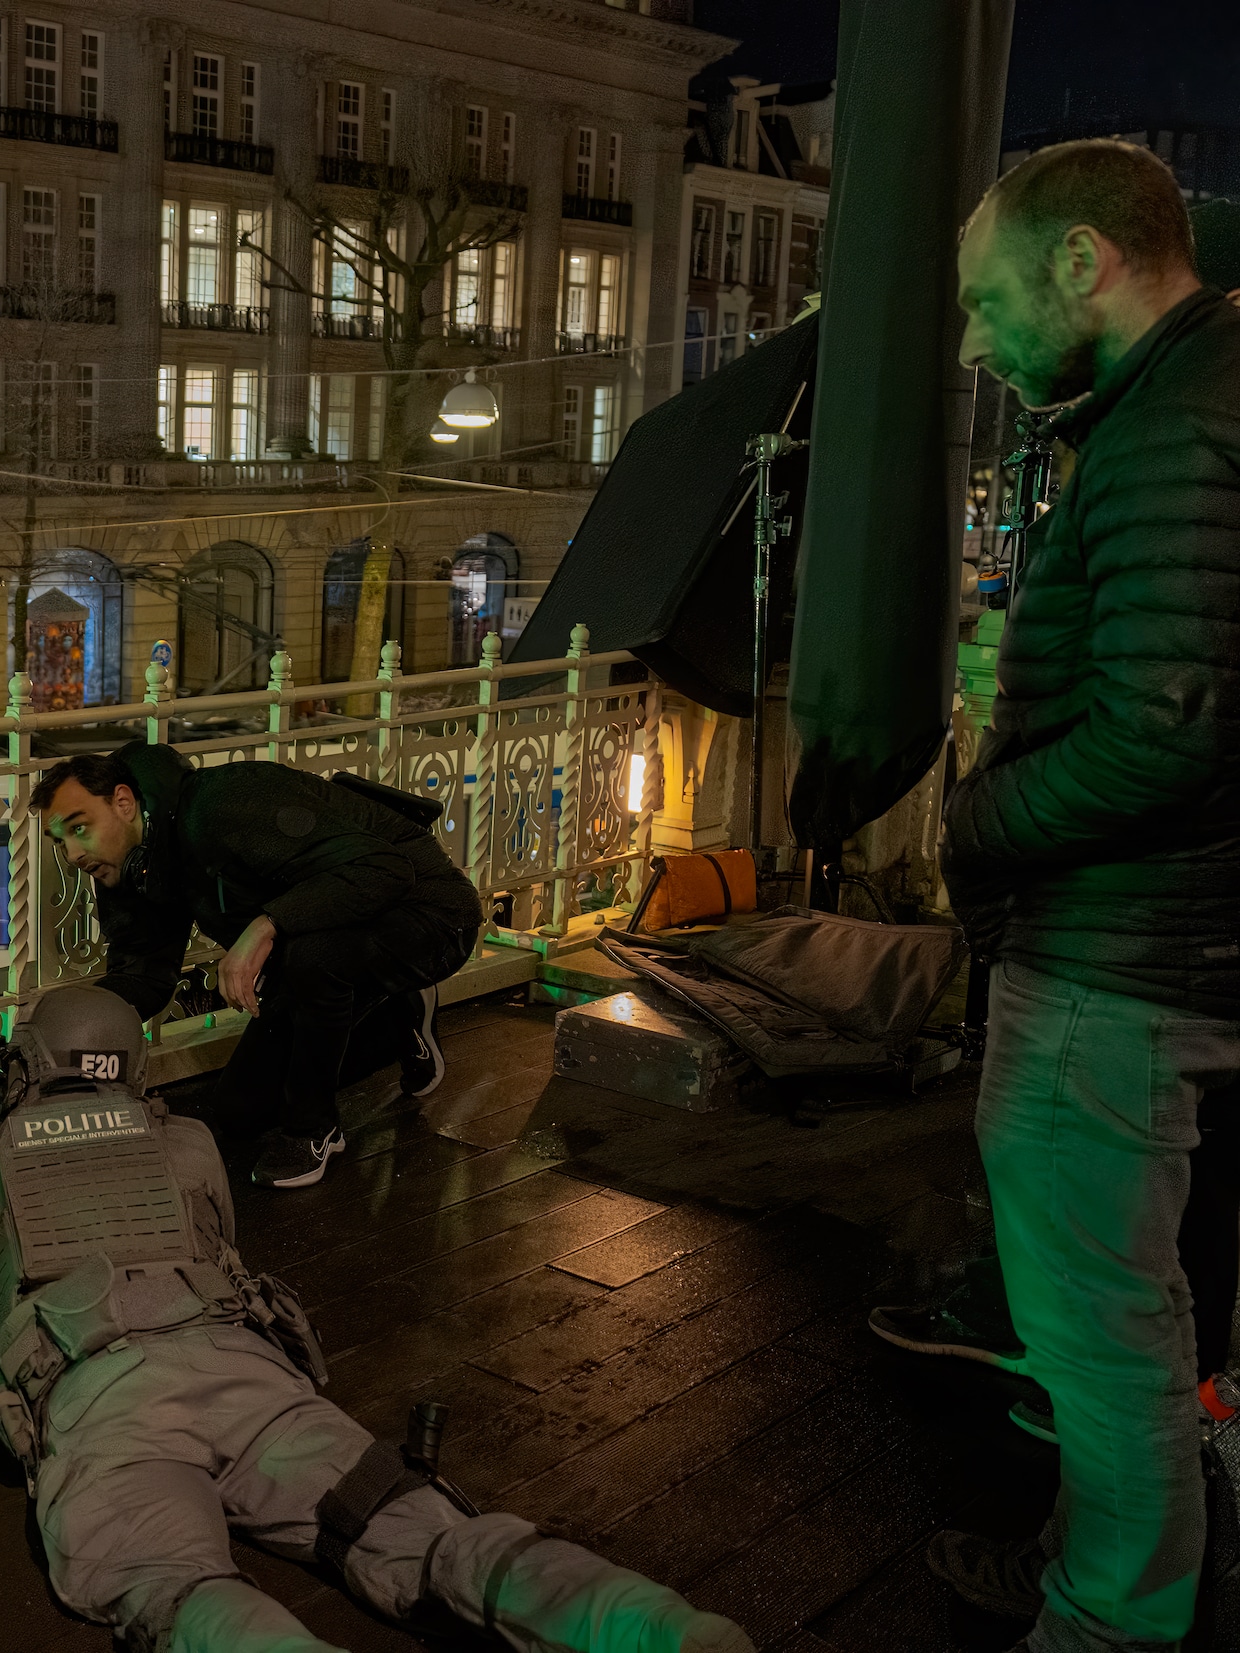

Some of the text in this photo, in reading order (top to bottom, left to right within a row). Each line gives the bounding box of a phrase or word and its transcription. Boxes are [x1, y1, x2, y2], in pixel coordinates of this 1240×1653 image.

[81, 1053, 120, 1080] E20
[24, 1111, 134, 1138] POLITIE
[18, 1138, 48, 1148] DIENST
[48, 1134, 88, 1144] SPECIALE
